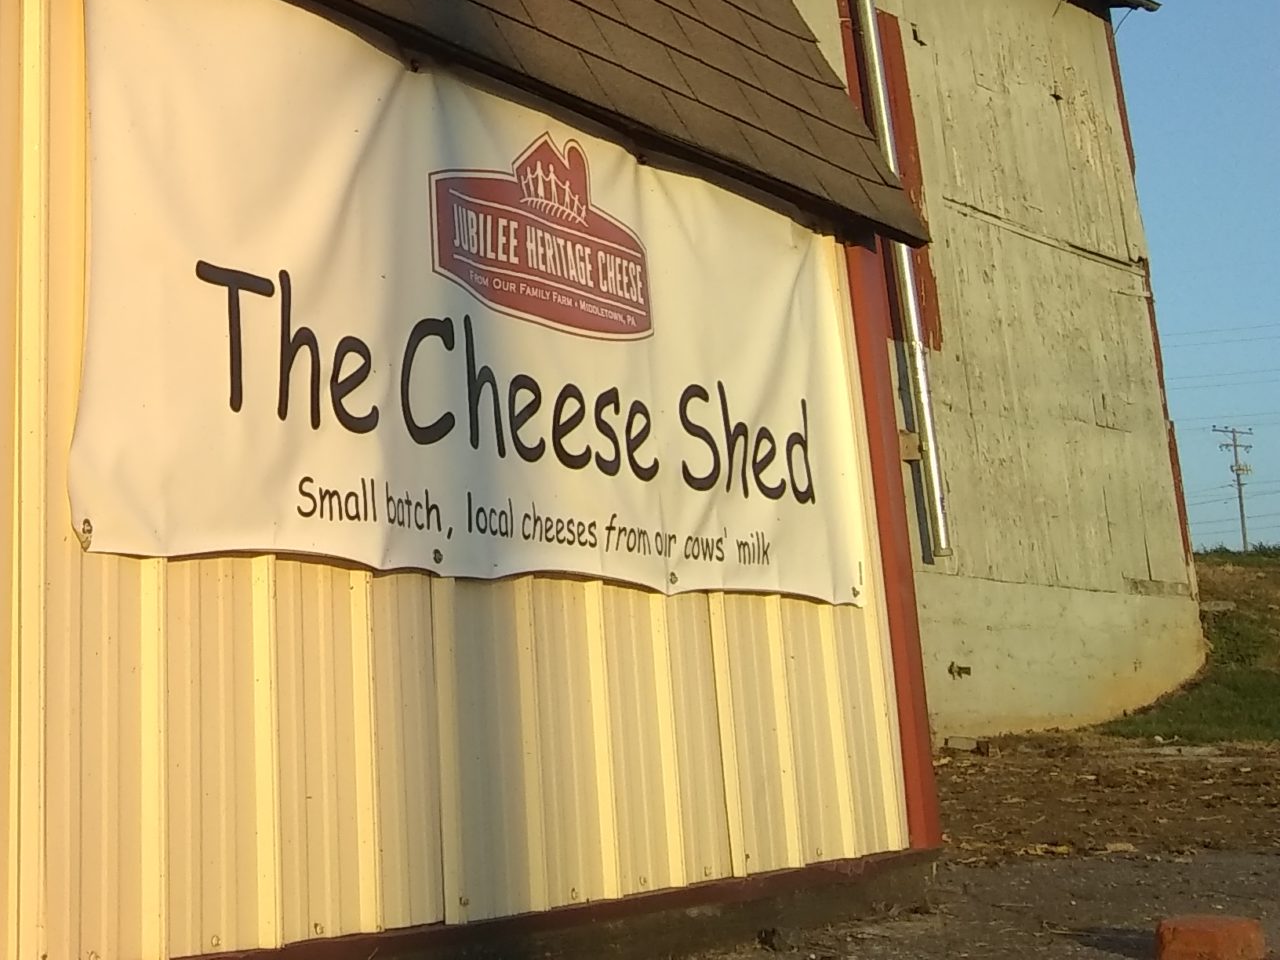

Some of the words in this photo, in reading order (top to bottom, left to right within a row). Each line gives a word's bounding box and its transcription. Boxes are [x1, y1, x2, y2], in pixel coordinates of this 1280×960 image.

[453, 203, 519, 265] JUBILEE
[525, 225, 594, 288] HERITAGE
[597, 250, 645, 305] CHEESE
[470, 270, 489, 288] FROM
[493, 277, 516, 293] OUR
[519, 283, 551, 301] FAMILY
[552, 292, 573, 307] FARM
[195, 258, 380, 435] The
[399, 313, 660, 482] Cheese
[679, 380, 817, 506] Shed
[296, 476, 377, 524] Small
[385, 481, 454, 540] batch,
[466, 491, 515, 539] local
[522, 501, 598, 548] cheeses
[604, 513, 652, 555] from
[683, 528, 728, 563] cows'
[734, 530, 771, 567] milk
